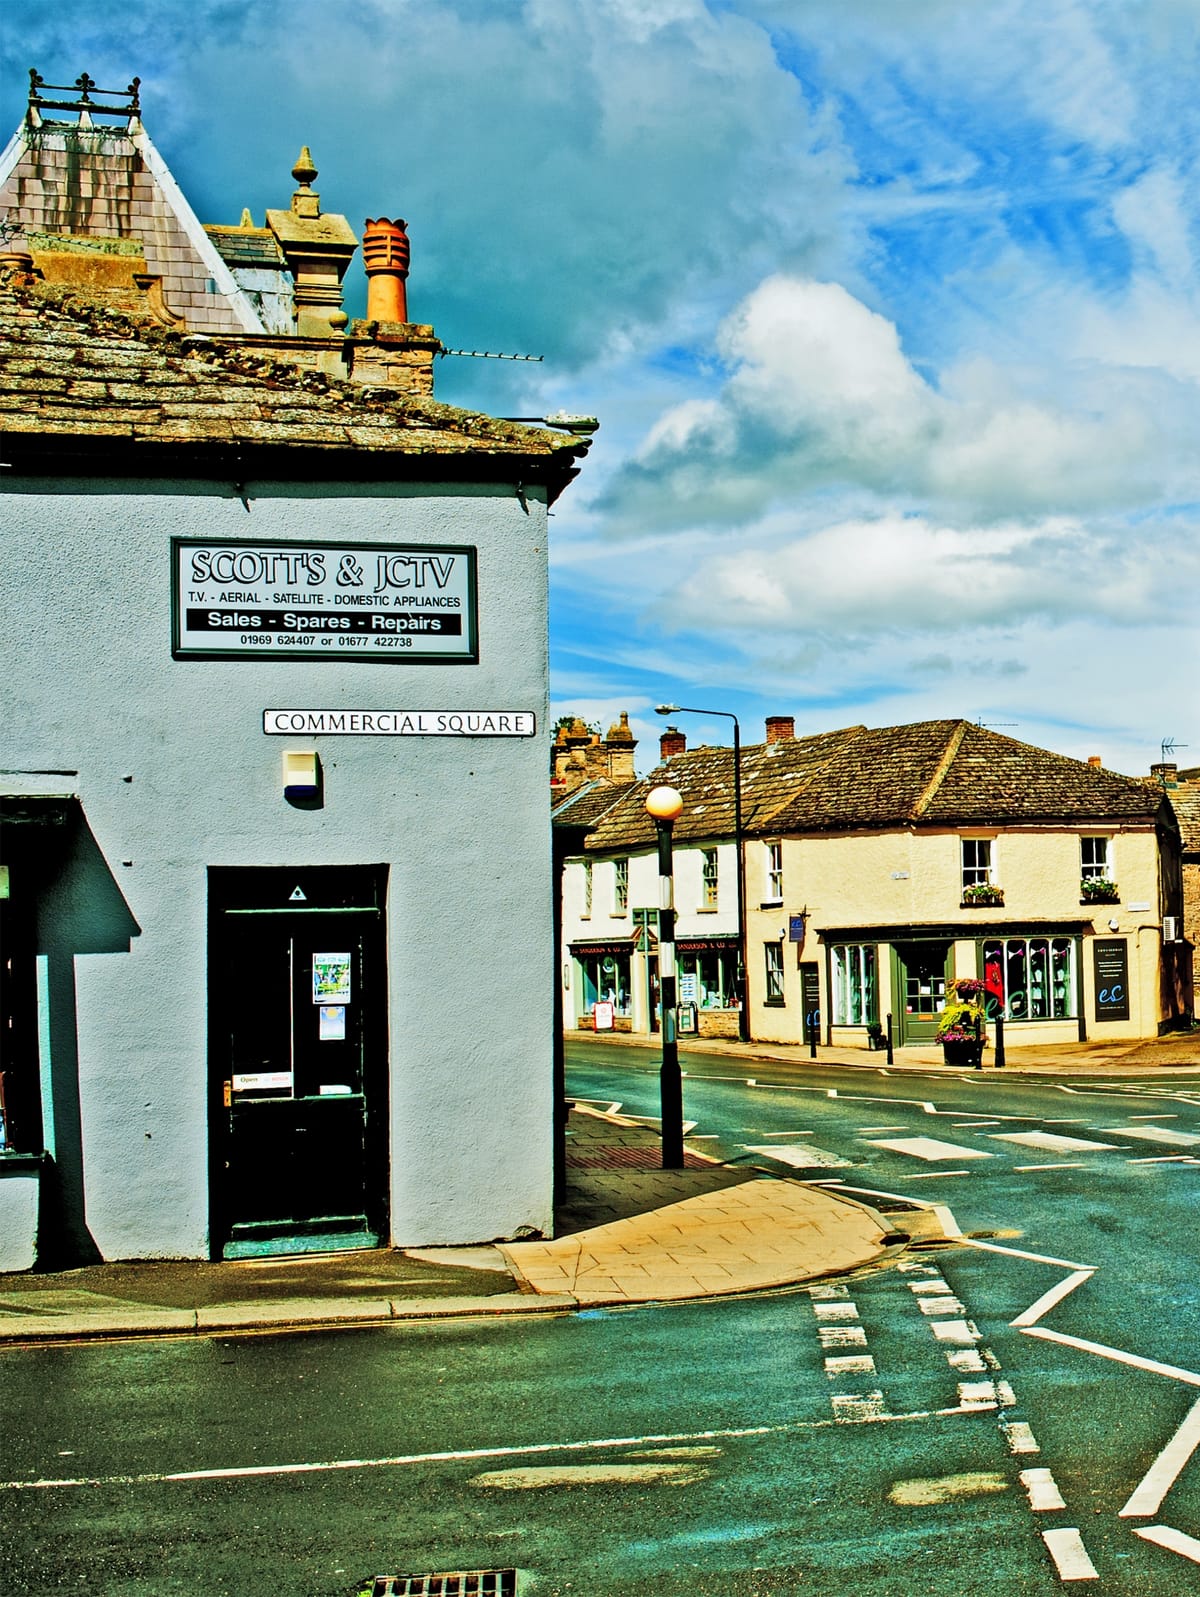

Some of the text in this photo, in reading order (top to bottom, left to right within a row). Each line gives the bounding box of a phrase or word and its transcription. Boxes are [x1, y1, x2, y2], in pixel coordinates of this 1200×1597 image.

[191, 550, 456, 594] SCOTT'S & JCTV
[188, 591, 207, 602] T.V.
[219, 592, 262, 603] AERIAL
[273, 593, 324, 604] SATELLITE
[334, 595, 390, 606] DOMESTIC
[394, 596, 461, 607] APPLIANCES
[207, 611, 262, 627] Sales
[283, 613, 352, 632] Spares
[371, 615, 442, 634] Repairs
[240, 634, 413, 648] 01969 624407 or 01677 422738
[274, 713, 525, 734] COMMERCIAL SQUARE
